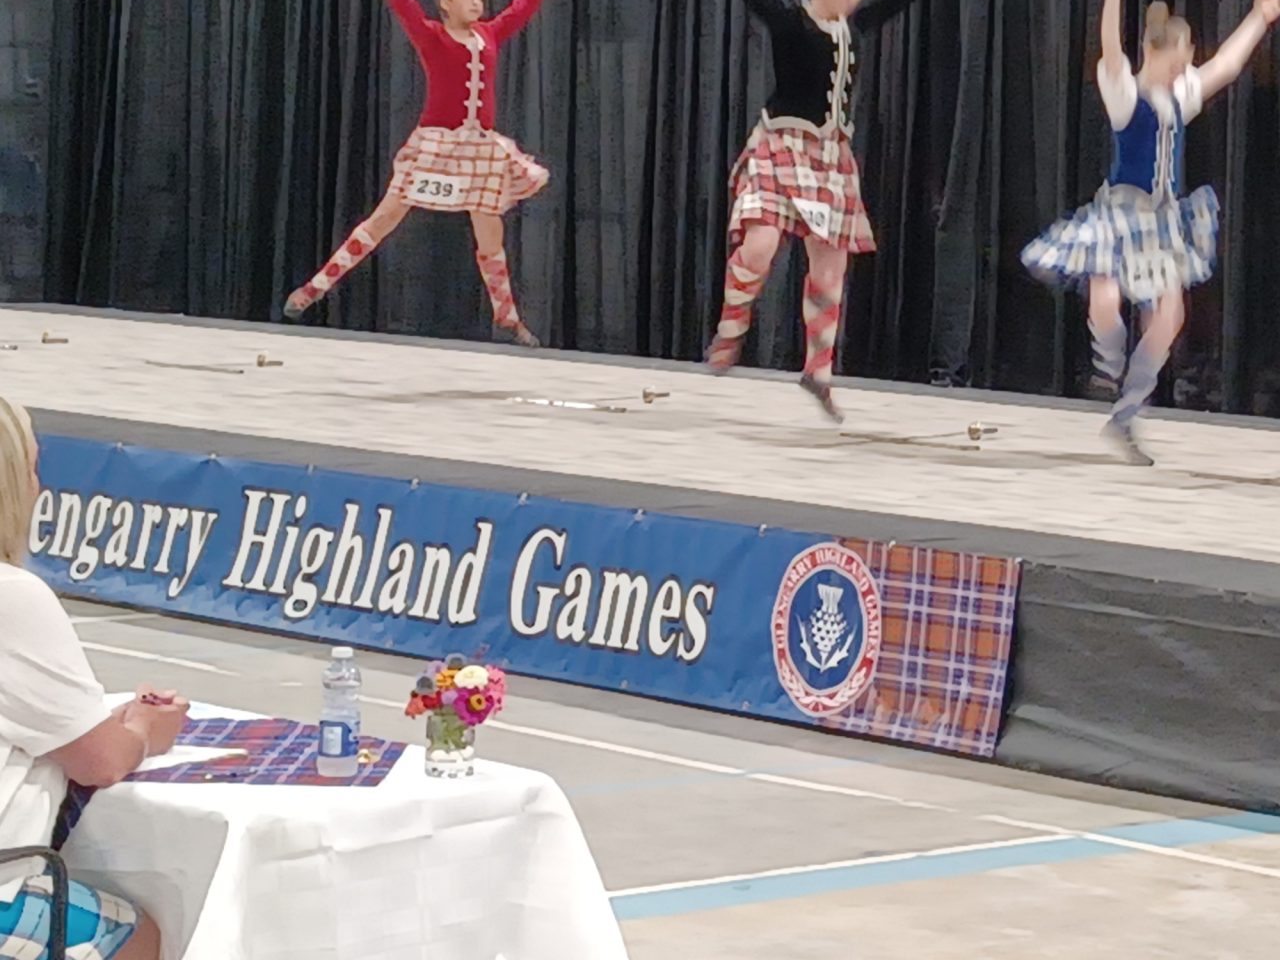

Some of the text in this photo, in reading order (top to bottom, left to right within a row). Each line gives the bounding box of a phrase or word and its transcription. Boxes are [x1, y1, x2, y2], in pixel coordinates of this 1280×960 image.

[417, 180, 453, 197] 239
[29, 487, 715, 662] engarry Highland Games
